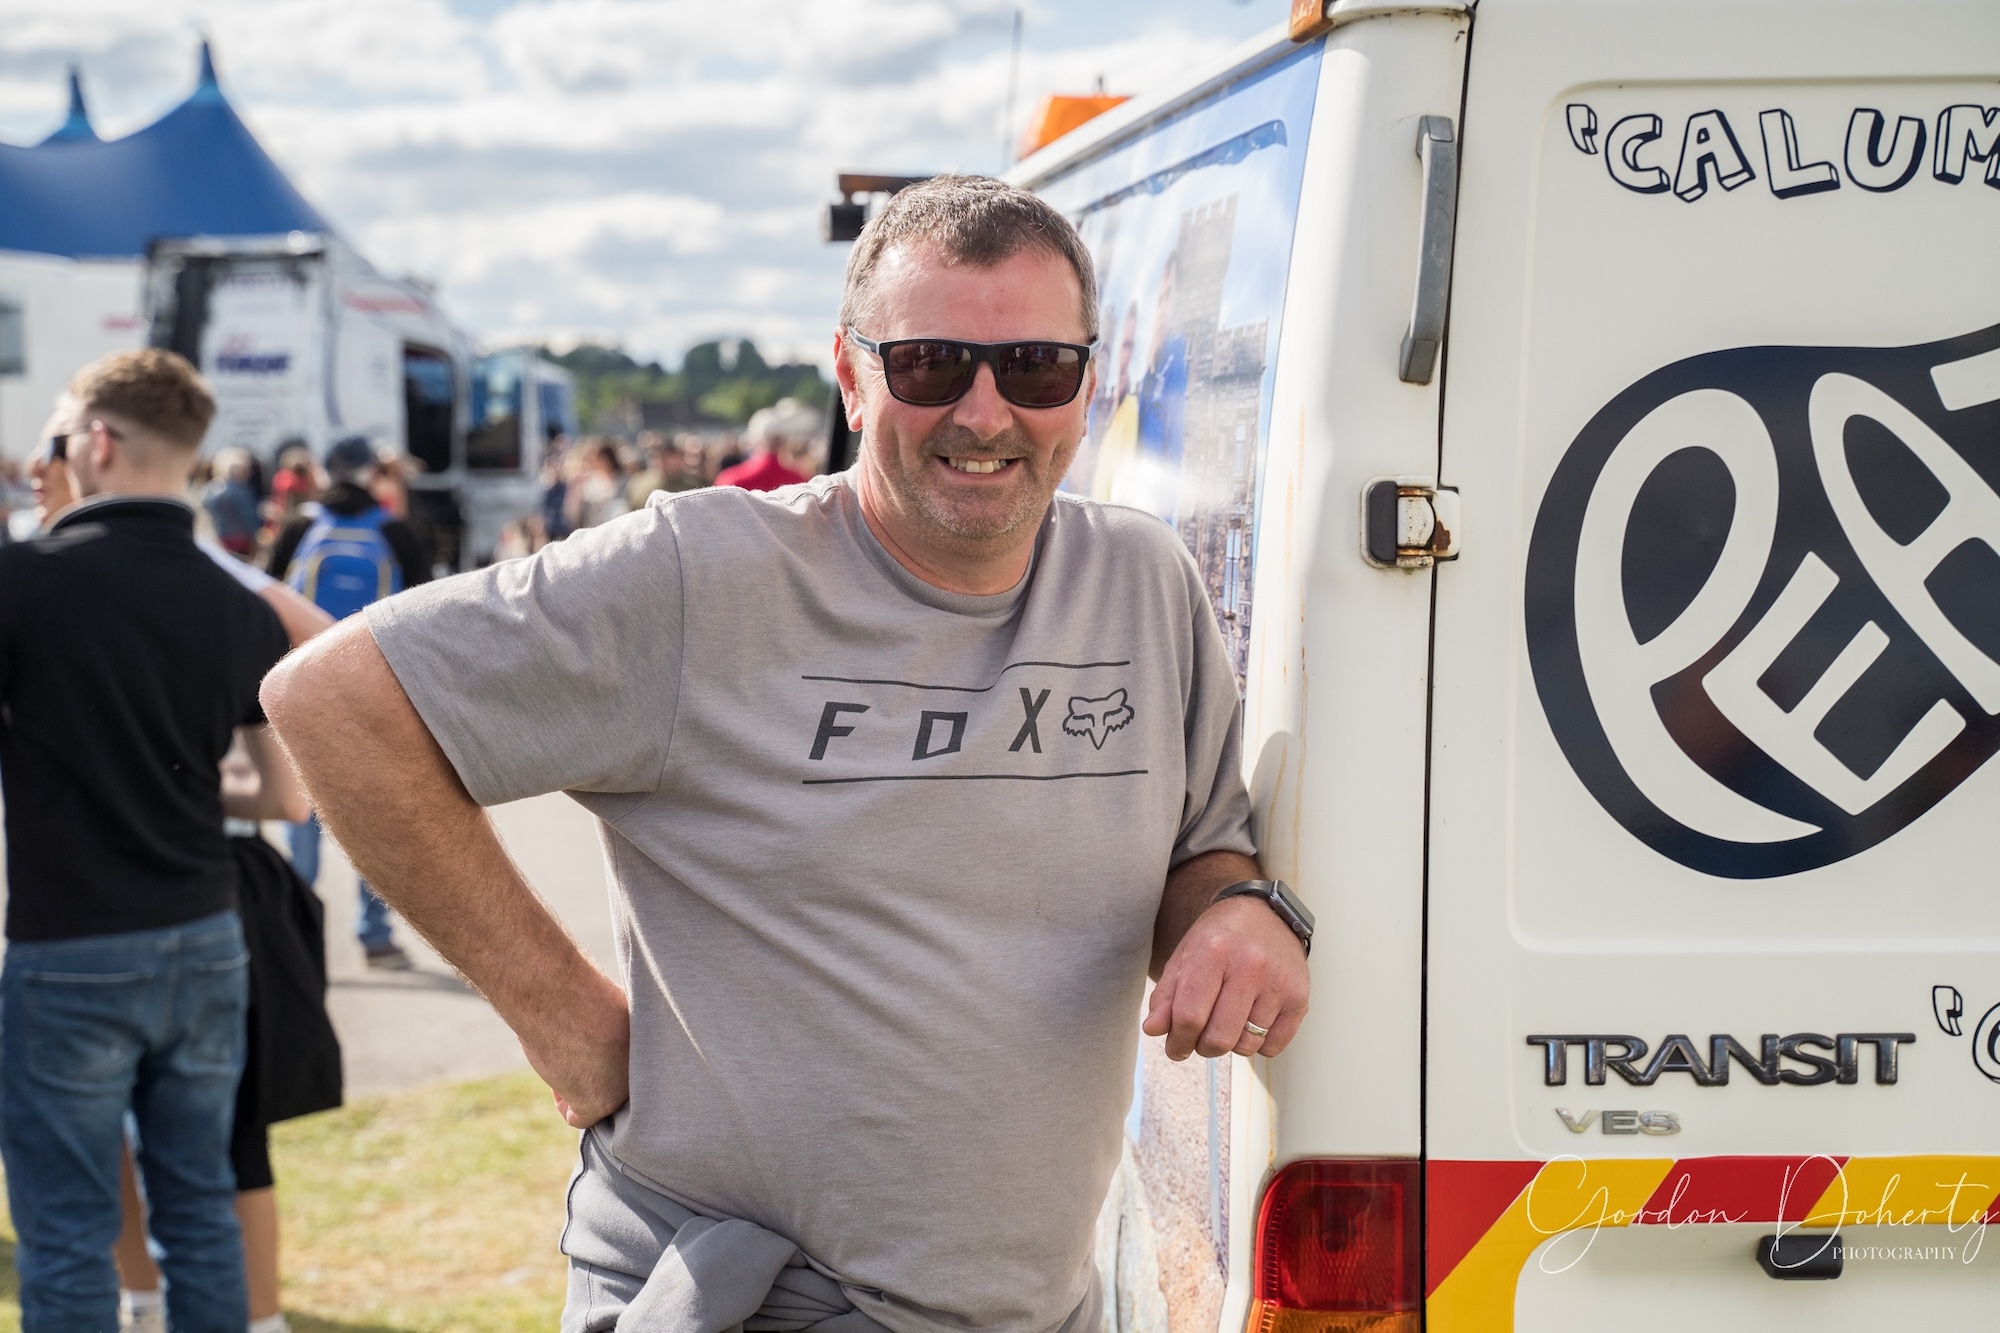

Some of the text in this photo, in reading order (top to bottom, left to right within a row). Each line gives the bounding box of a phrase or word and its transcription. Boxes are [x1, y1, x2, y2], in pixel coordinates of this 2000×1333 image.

[809, 687, 1051, 761] FOX
[1526, 1033, 1916, 1086] TRANSIT
[1555, 1107, 1682, 1136] VES
